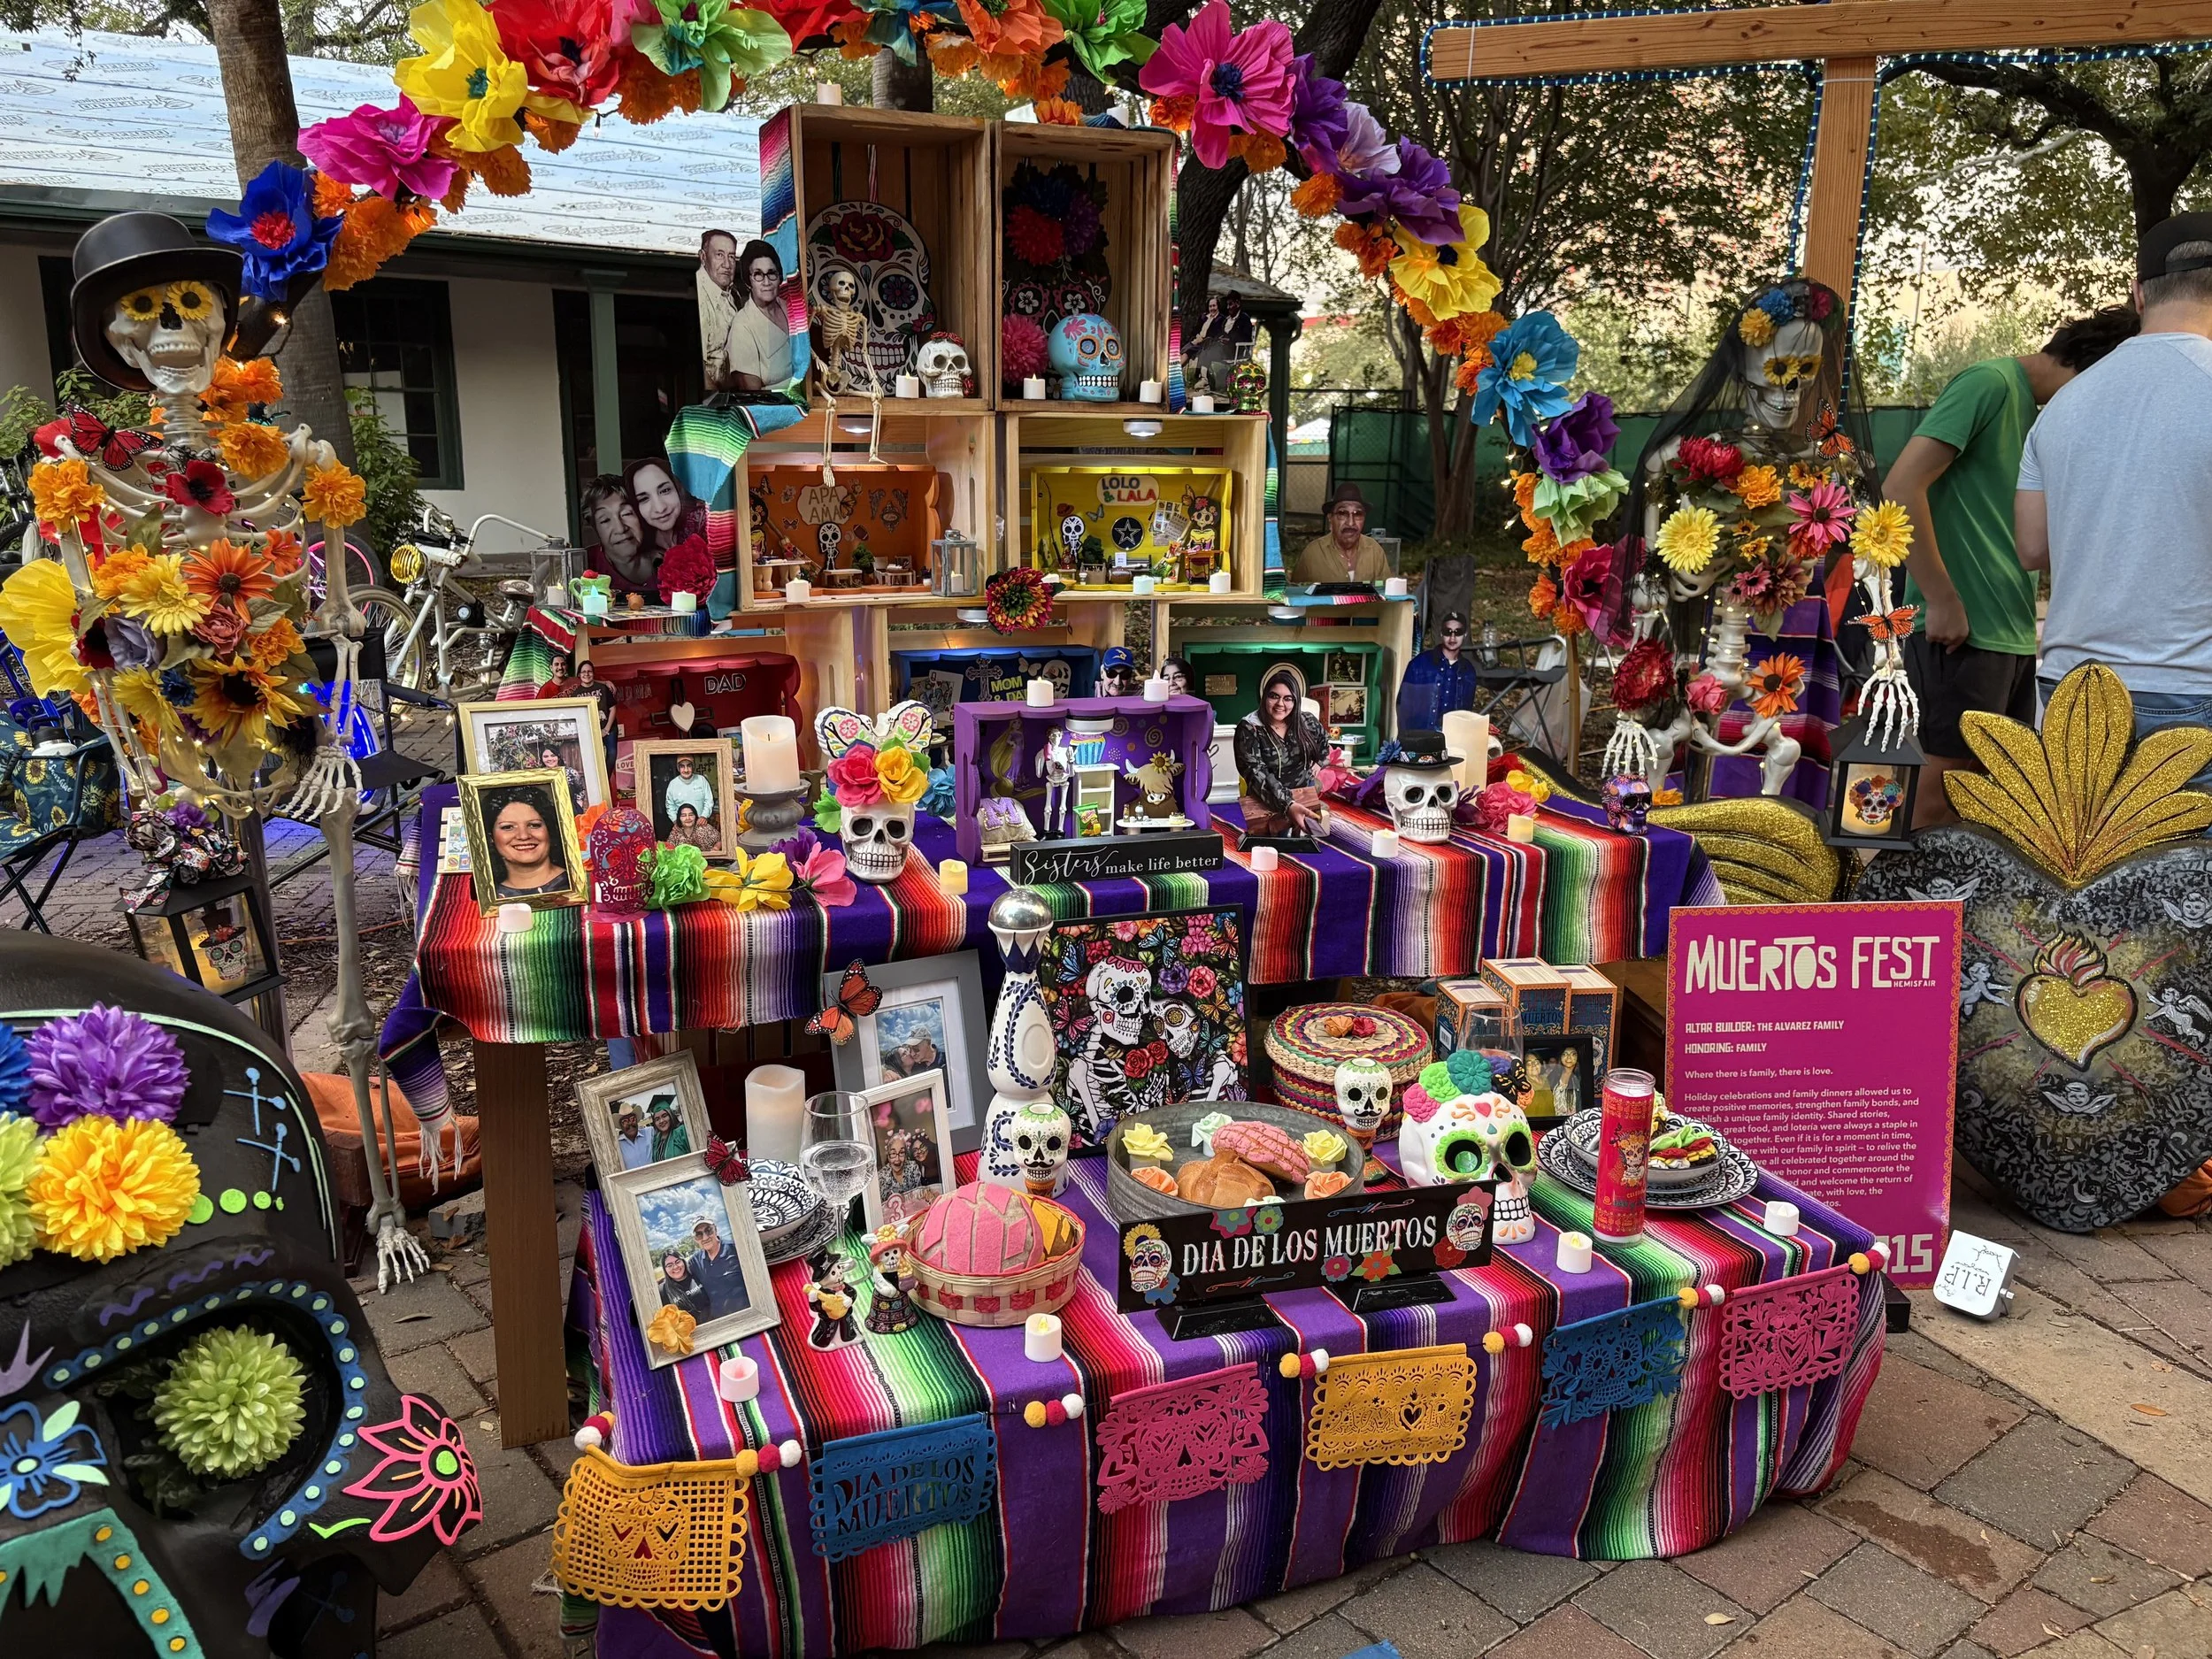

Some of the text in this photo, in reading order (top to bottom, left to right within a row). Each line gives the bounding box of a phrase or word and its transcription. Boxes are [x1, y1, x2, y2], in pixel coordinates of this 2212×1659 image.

[1102, 477, 1141, 490] LOLO
[1118, 488, 1156, 503] LALA
[704, 673, 747, 695] DAD
[990, 675, 1023, 693] MOM
[1005, 689, 1028, 702] DA
[617, 759, 634, 769] LOVE
[1024, 846, 1218, 884] Sisters make life better
[1686, 935, 1940, 994] MUERTOS FEST
[1686, 1020, 1844, 1033] ALTAR BUILDER: THE ALVAREZ FAMILY
[1685, 1042, 1767, 1054] HONORING: FAMILY
[1749, 1068, 1777, 1079] family,
[1685, 1093, 1717, 1102] Holiday
[1720, 1091, 1772, 1100] celebrations
[1793, 1089, 1819, 1099] family
[1855, 1087, 1888, 1096] allowed
[1713, 1103, 1747, 1113] positive
[1795, 1100, 1841, 1110] strengthen
[1844, 1099, 1870, 1109] family
[1871, 1098, 1901, 1107] bonds,
[1902, 1097, 1918, 1106] and
[1732, 1114, 1761, 1124] unique
[1763, 1112, 1789, 1122] family
[1791, 1111, 1825, 1121] identity.
[1860, 1110, 1890, 1118] stories,
[1724, 1126, 1746, 1135] great
[1748, 1124, 1770, 1133] food,
[1843, 1121, 1872, 1131] always
[1882, 1120, 1908, 1130] staple
[1734, 1136, 1771, 1145] together.
[1822, 1133, 1834, 1141] for
[1797, 1144, 1823, 1155] family
[1835, 1143, 1856, 1154] spirit
[1782, 1156, 1826, 1164] celebrated
[1830, 1155, 1866, 1164] together
[1868, 1153, 1899, 1162] around
[1832, 1165, 1893, 1174] commemorate
[1182, 1215, 1438, 1277] DIA DE LOS MUERTOS
[833, 1455, 975, 1515] DIA DE LOS
[835, 1481, 973, 1538] MUERTOS
